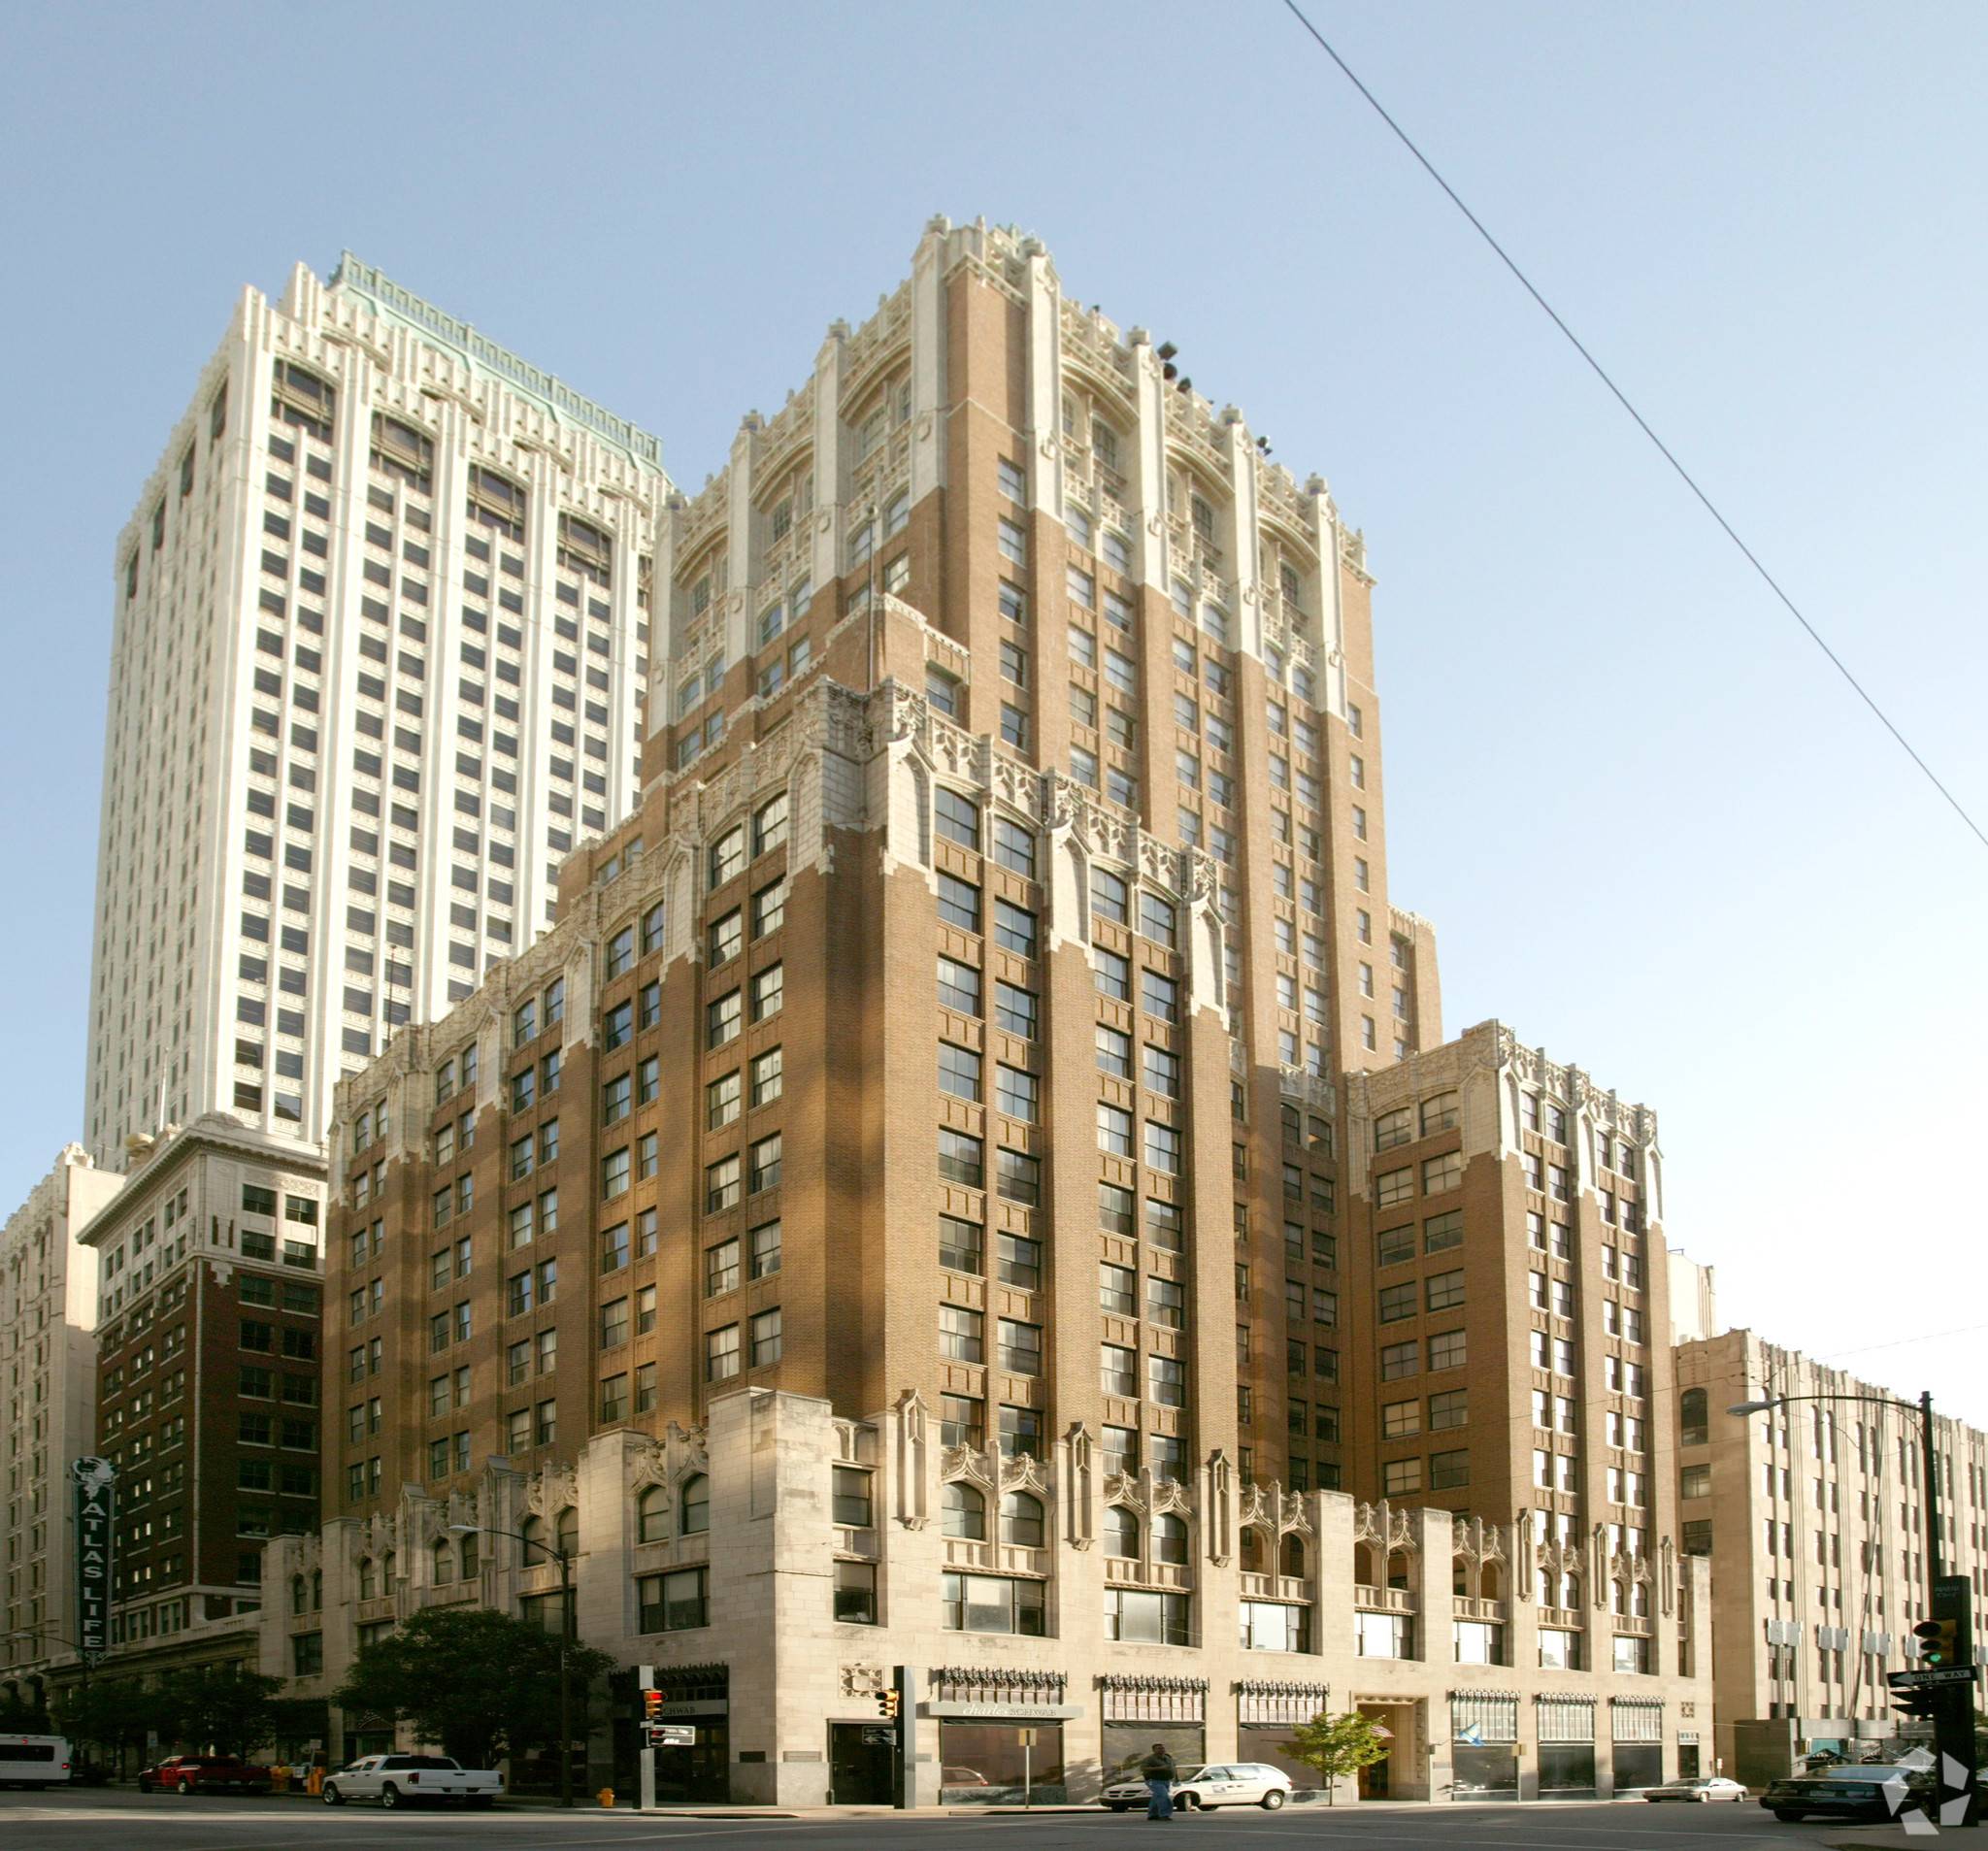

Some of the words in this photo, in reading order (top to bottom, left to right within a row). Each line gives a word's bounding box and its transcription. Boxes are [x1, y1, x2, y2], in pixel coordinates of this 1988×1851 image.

[82, 1503, 106, 1578] ATLAS
[83, 1587, 103, 1647] LIFE
[1943, 1669, 1965, 1678] WAY
[662, 1706, 696, 1715] CHWAB
